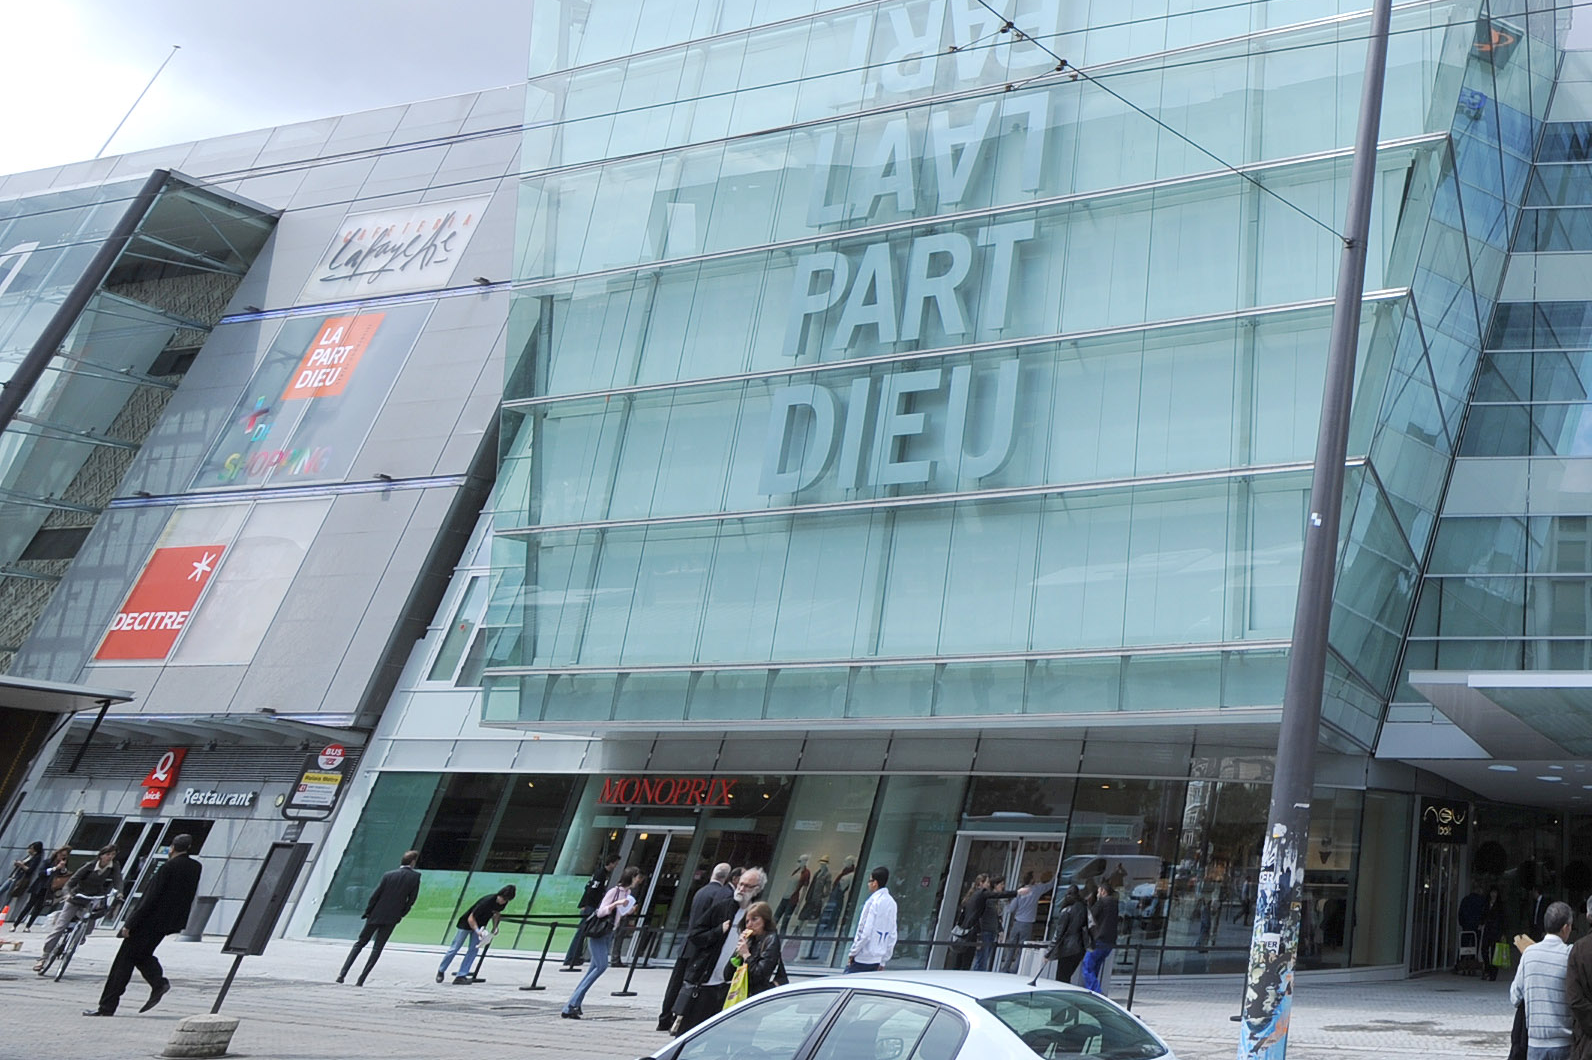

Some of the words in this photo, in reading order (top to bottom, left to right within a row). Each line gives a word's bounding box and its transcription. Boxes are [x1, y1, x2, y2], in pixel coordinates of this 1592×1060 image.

[806, 117, 916, 228] LA
[782, 220, 1036, 356] PART
[320, 326, 344, 345] LA
[306, 345, 354, 366] PART
[294, 367, 342, 389] DIEU
[757, 359, 1021, 496] DIEU
[110, 611, 191, 631] DECITRE
[325, 747, 343, 756] BUS
[184, 787, 255, 807] Restaurant
[597, 776, 738, 805] MONOPRIX
